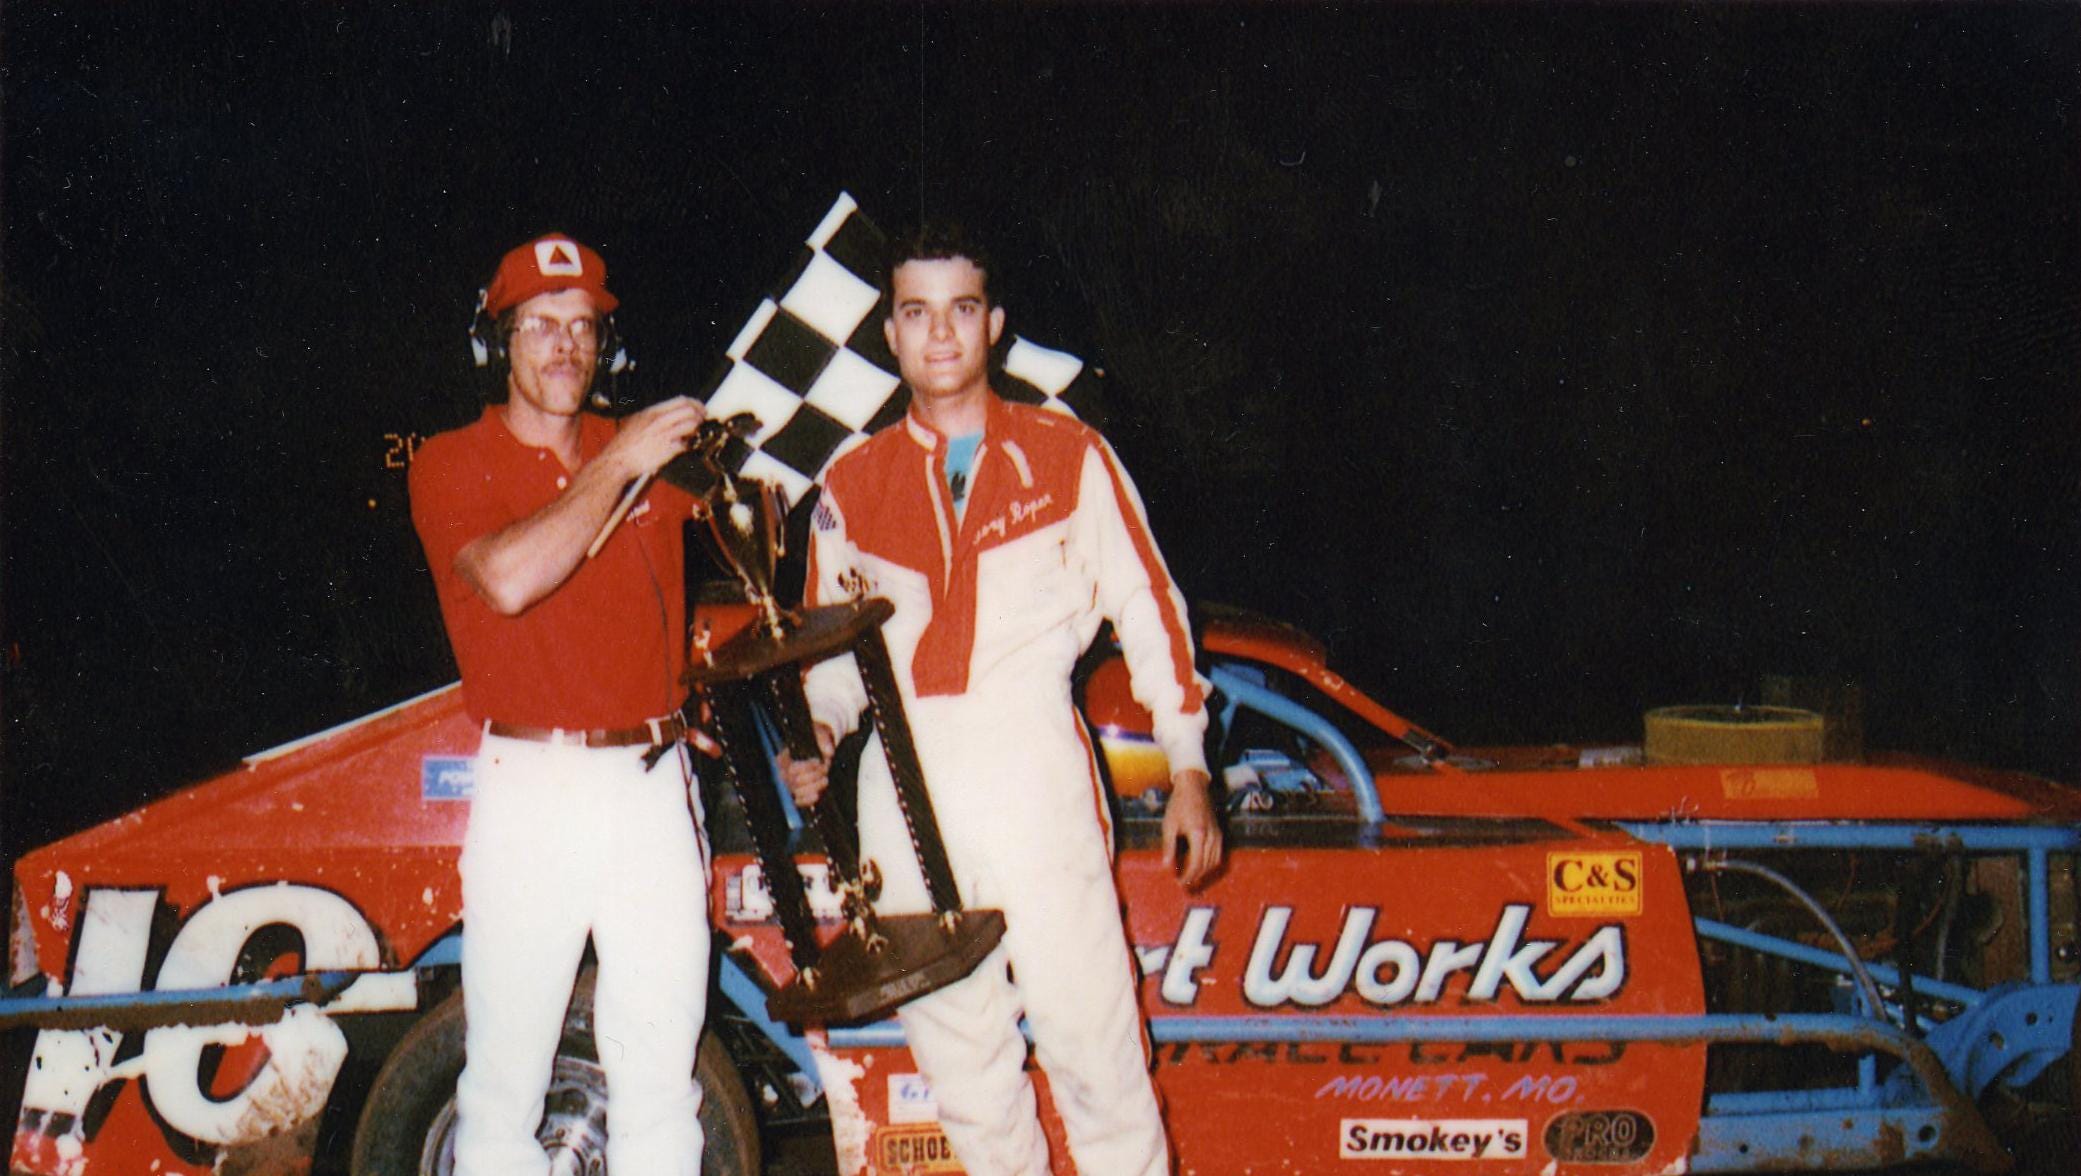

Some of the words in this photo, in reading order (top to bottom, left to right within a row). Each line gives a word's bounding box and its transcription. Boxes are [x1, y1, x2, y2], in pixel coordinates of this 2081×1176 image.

[1553, 858, 1636, 892] C&S
[1244, 904, 1625, 1006] Works
[1347, 1124, 1522, 1157] Smokey's
[1552, 1112, 1637, 1147] PRO
